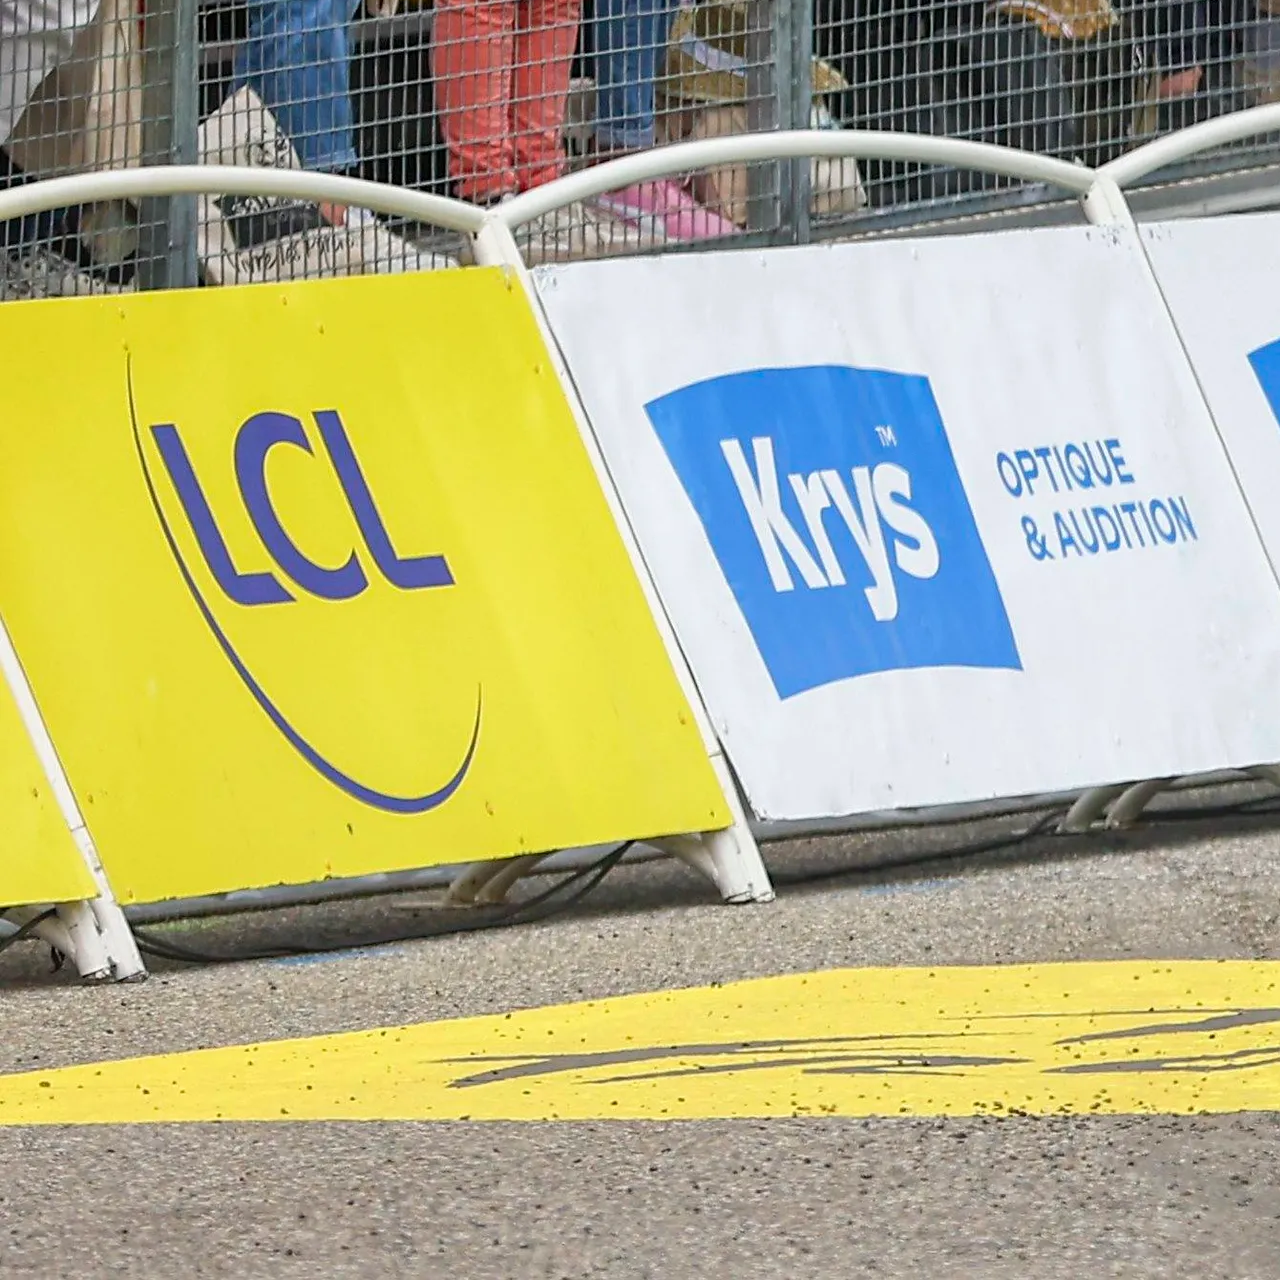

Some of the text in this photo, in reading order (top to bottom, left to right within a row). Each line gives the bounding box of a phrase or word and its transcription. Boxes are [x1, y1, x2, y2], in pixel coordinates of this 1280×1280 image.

[148, 409, 456, 607] LCL
[719, 435, 940, 621] Krys
[996, 437, 1136, 499] OPTIQUE
[1021, 495, 1198, 562] & AUDITION
